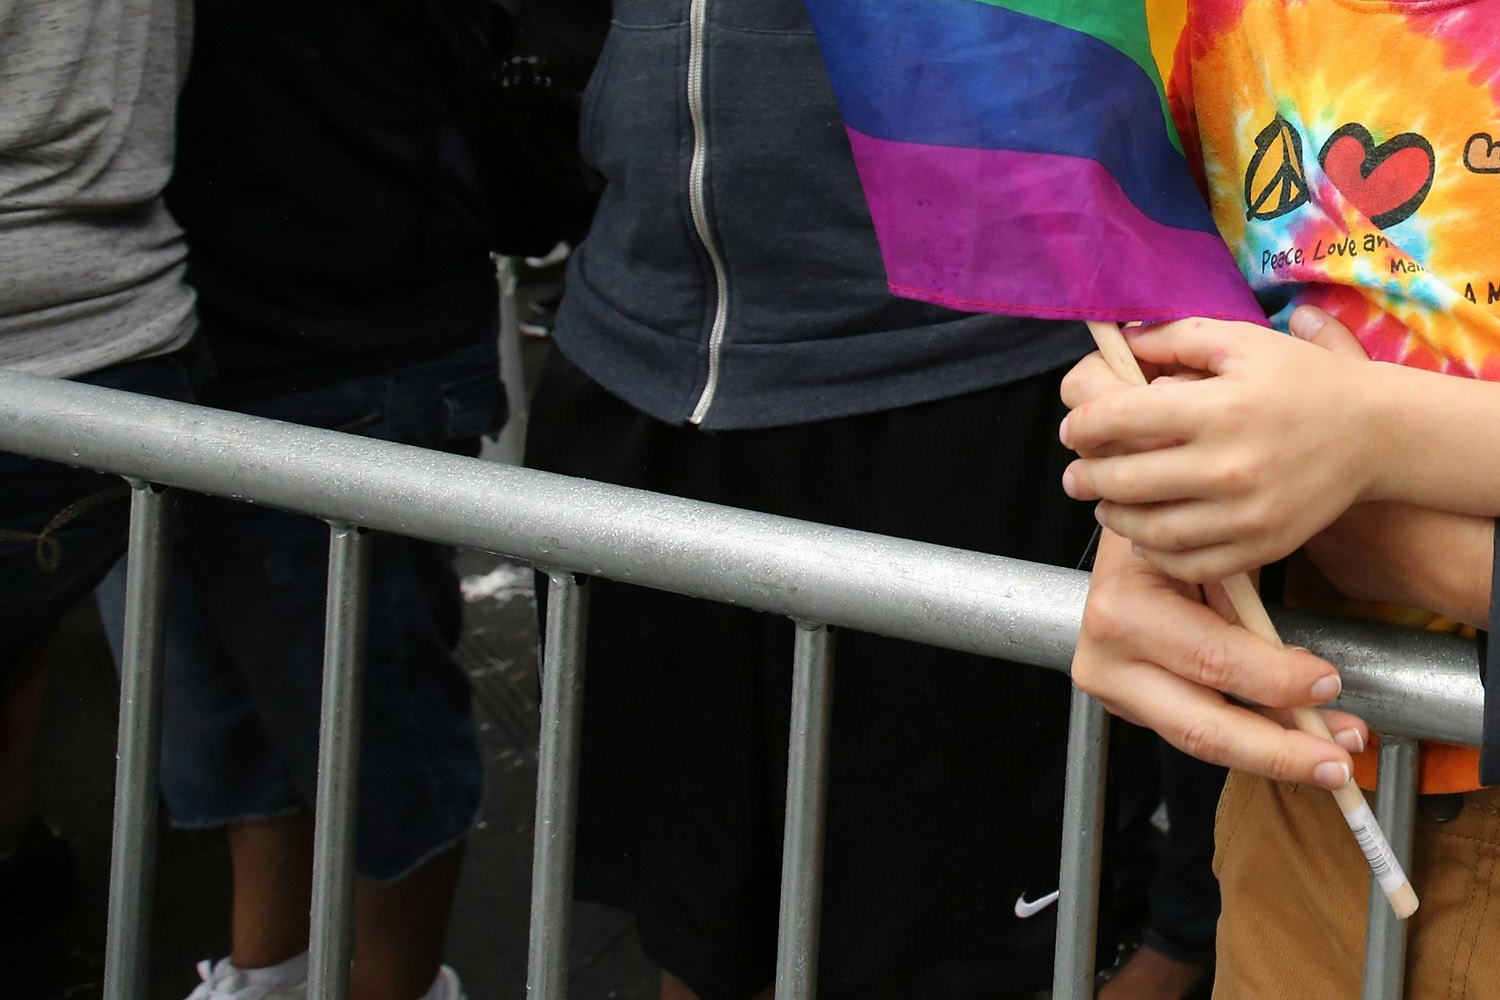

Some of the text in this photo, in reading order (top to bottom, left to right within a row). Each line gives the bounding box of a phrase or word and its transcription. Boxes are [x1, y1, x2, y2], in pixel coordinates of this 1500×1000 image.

[1261, 248, 1305, 275] Peace,
[1312, 237, 1358, 261] Love
[1363, 233, 1392, 252] an
[1464, 281, 1477, 304] A
[1390, 258, 1425, 274] Mai
